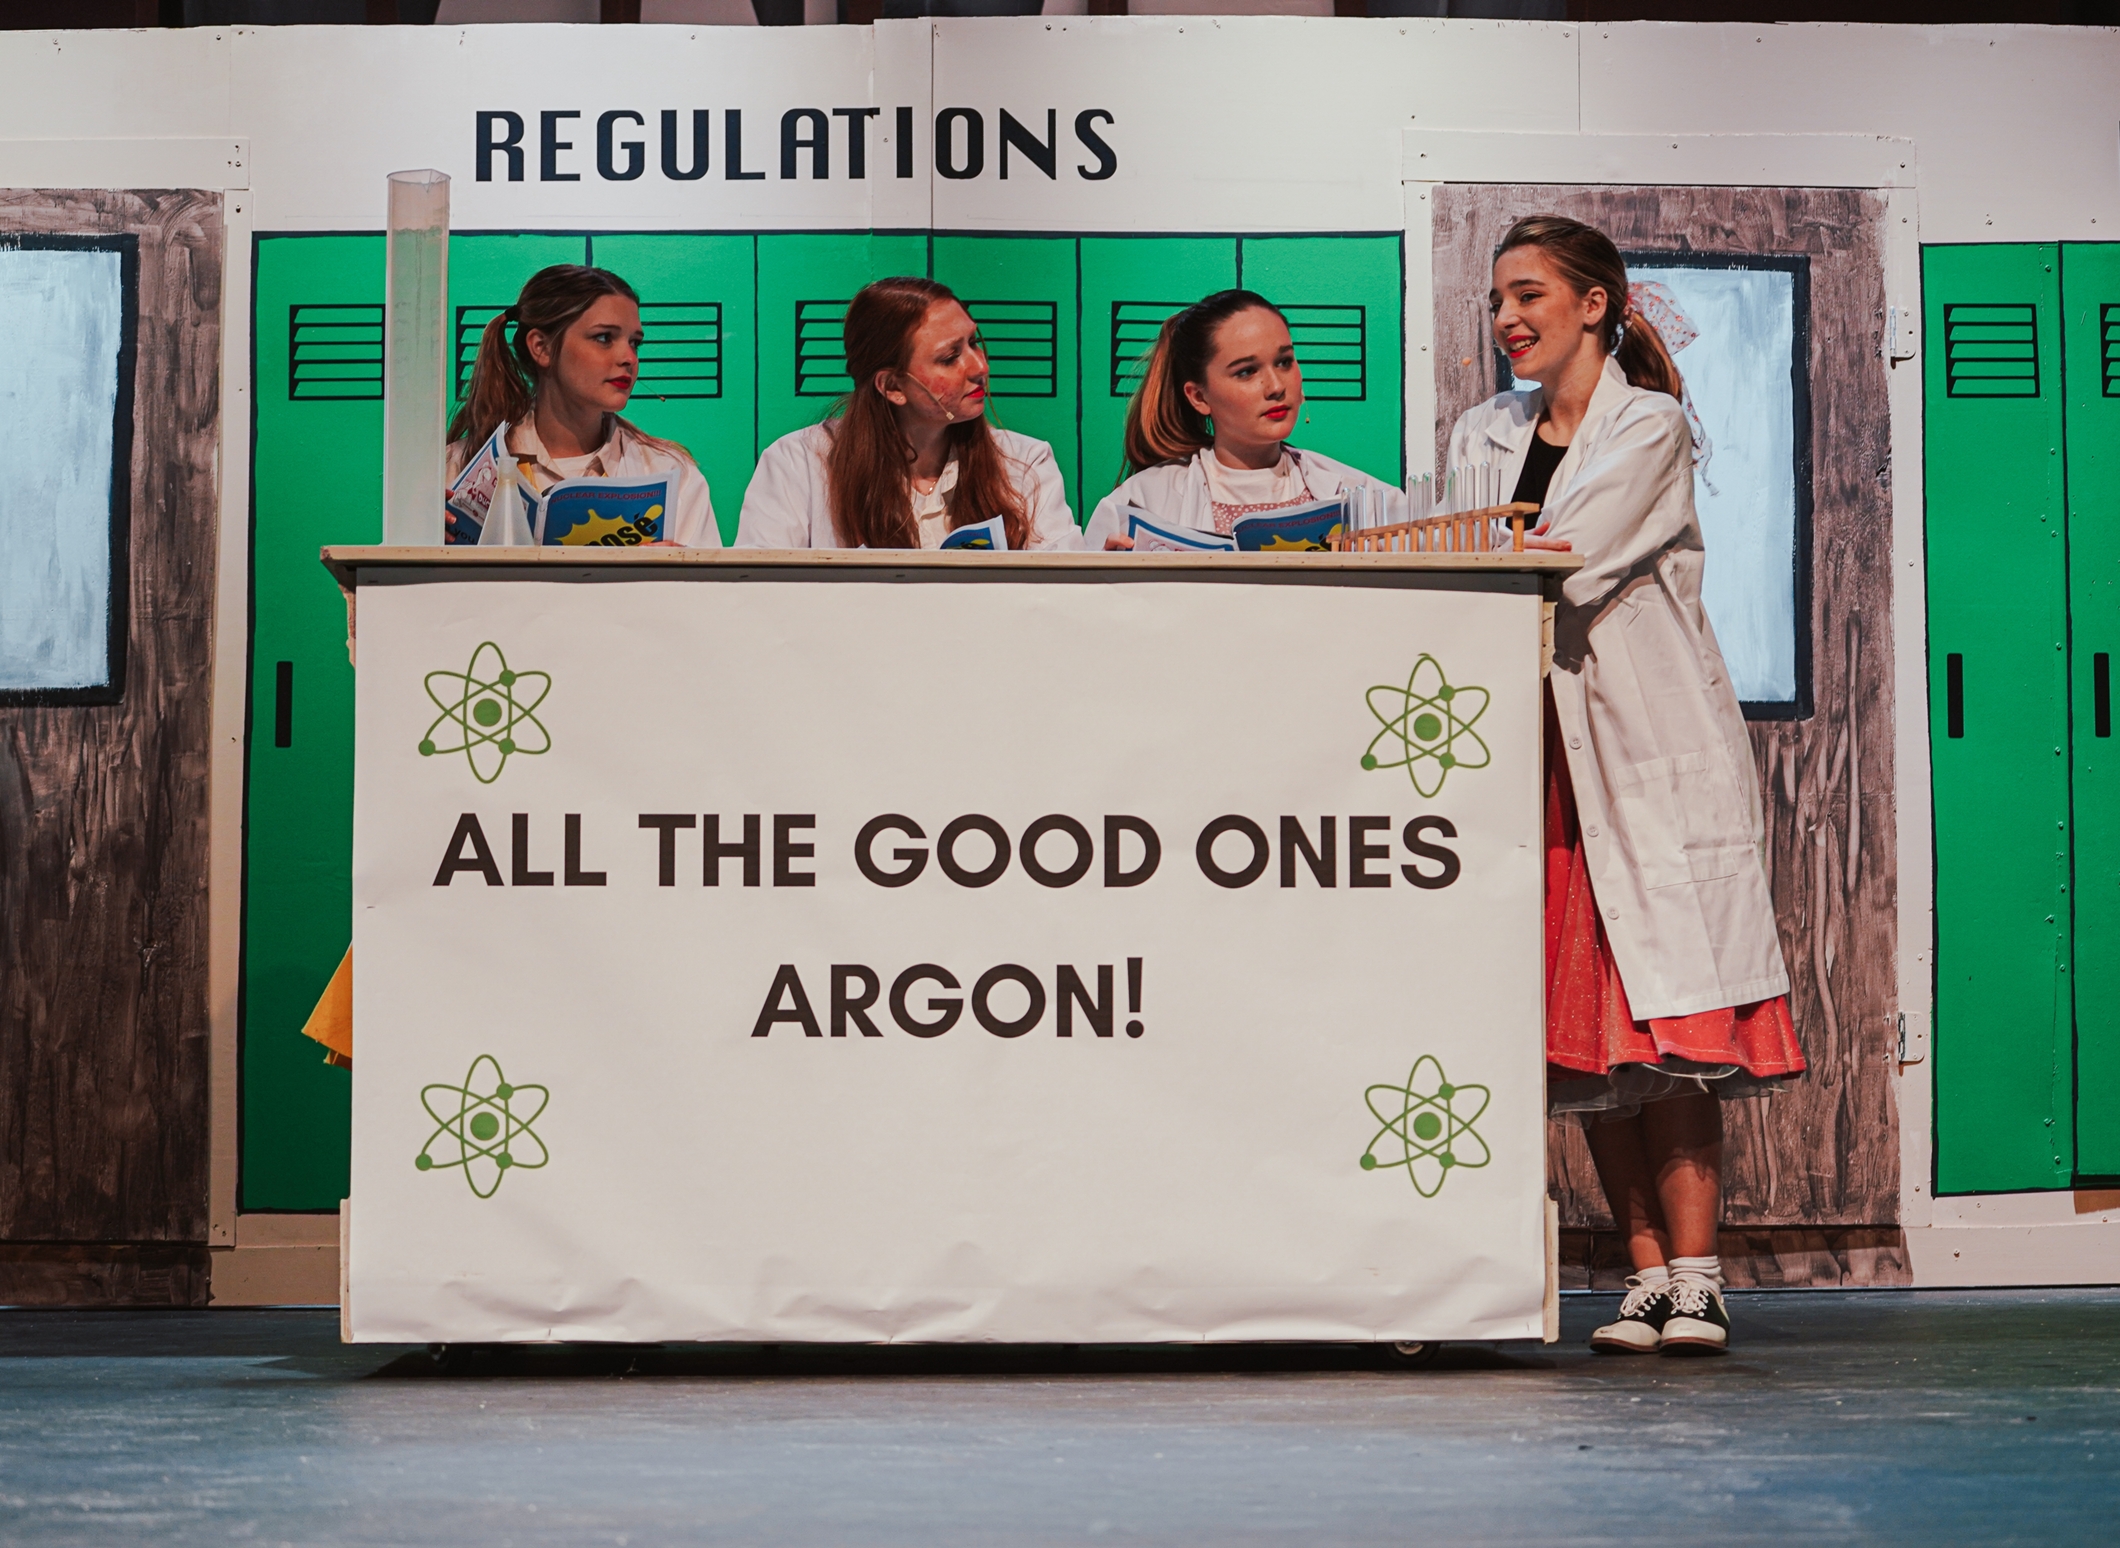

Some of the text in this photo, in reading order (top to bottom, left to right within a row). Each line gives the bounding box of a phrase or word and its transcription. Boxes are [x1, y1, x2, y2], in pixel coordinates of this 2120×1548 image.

[475, 106, 1118, 182] REGULATIONS
[551, 491, 596, 504] NUCLEAR
[432, 812, 1461, 890] ALL THE GOOD ONES
[750, 957, 1145, 1039] ARGON!
